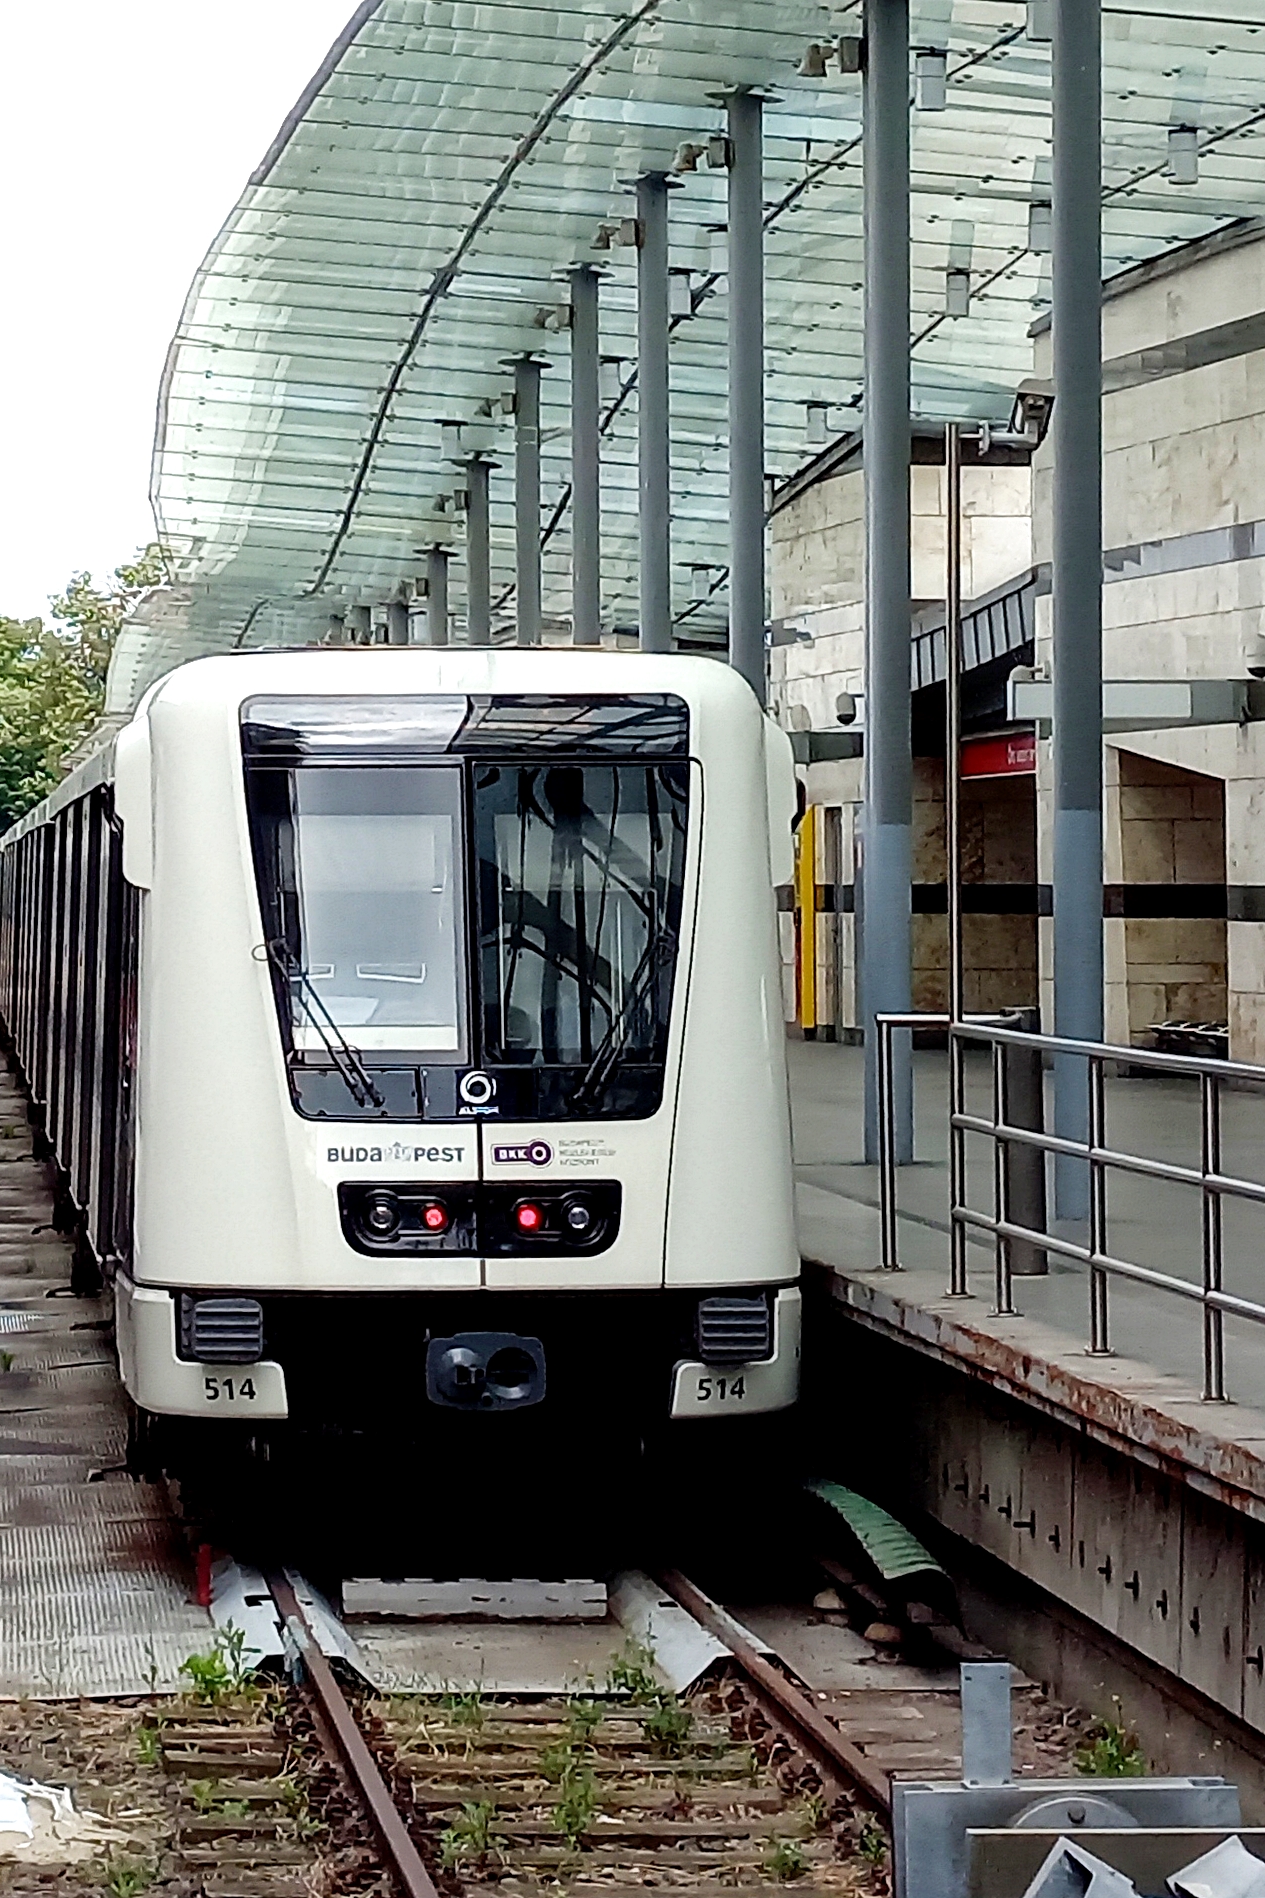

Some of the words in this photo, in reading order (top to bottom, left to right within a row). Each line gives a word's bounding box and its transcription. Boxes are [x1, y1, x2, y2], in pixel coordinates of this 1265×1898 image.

[498, 1148, 527, 1160] BKK
[205, 1377, 256, 1400] 514
[697, 1376, 745, 1401] 514
